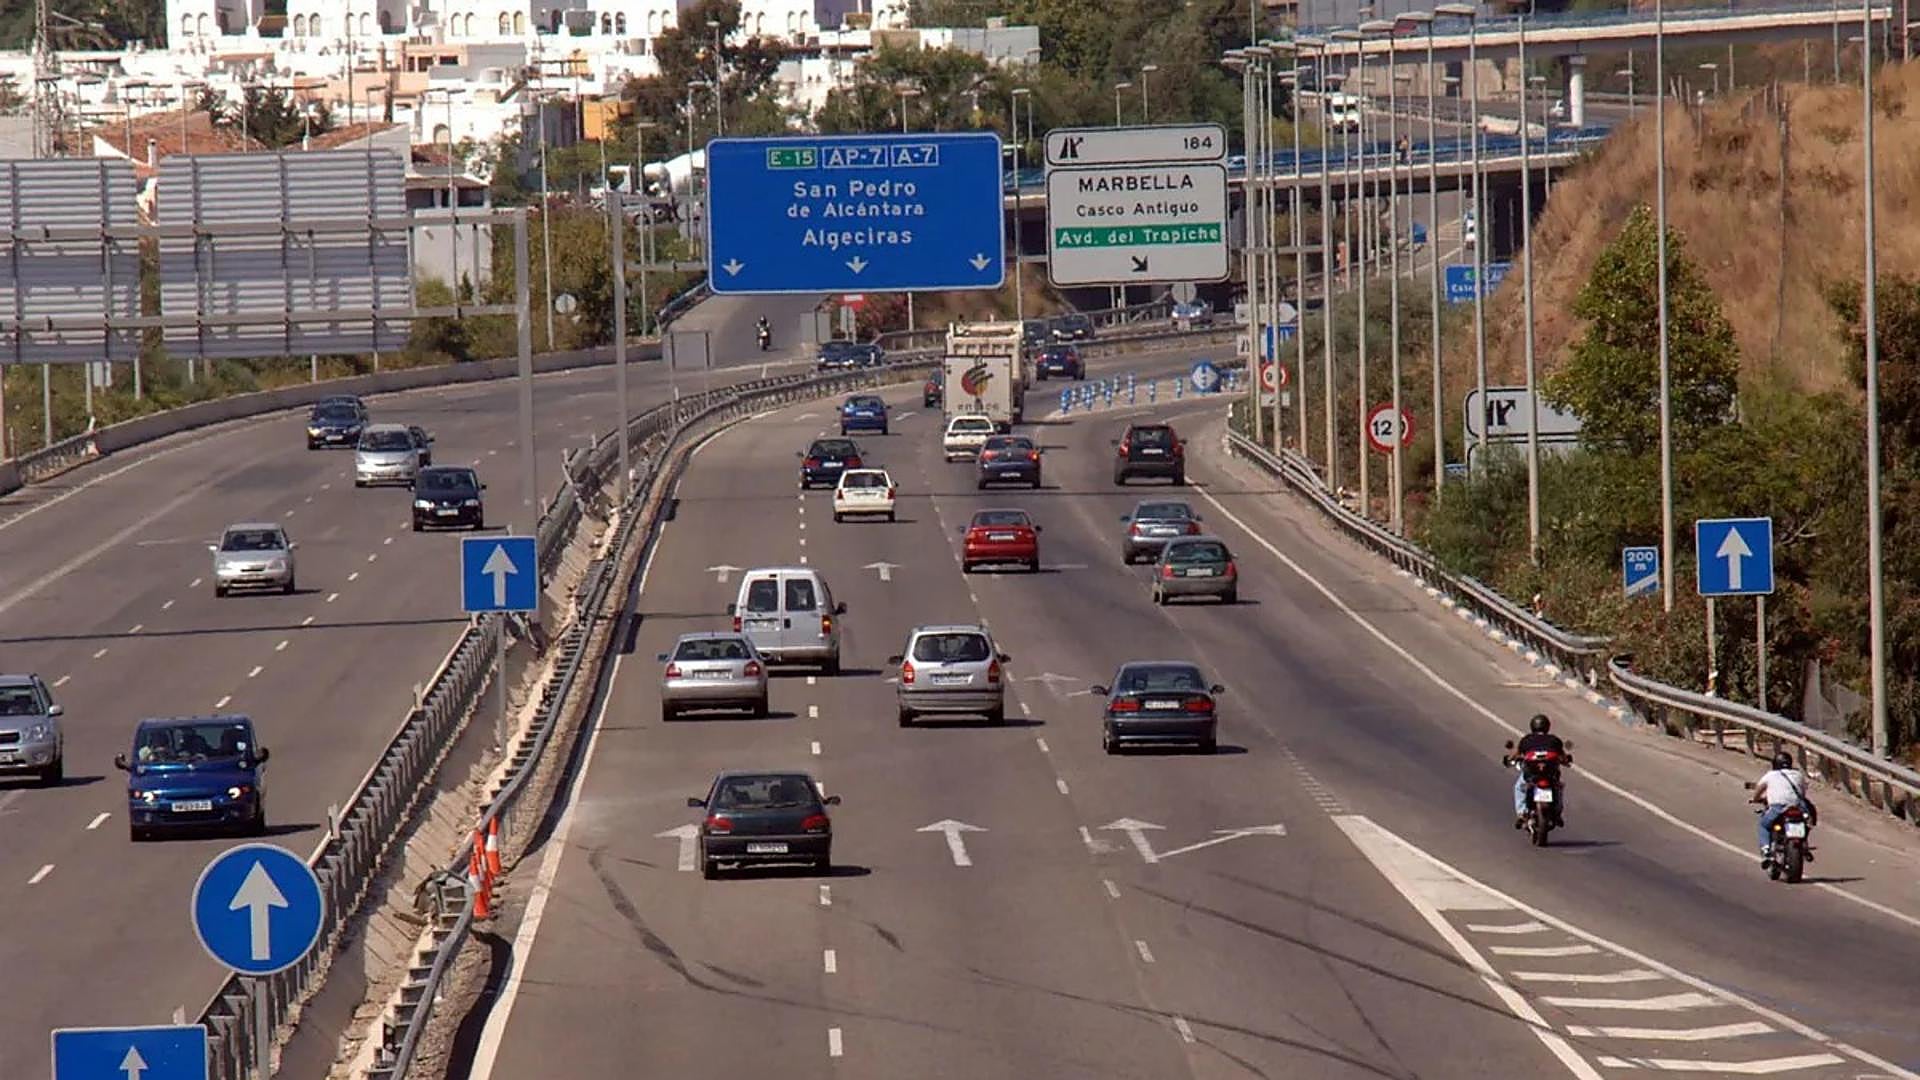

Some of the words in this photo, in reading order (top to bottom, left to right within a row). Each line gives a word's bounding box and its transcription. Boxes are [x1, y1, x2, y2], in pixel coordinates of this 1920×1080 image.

[1183, 136, 1213, 150] 184
[770, 150, 814, 166] E-15
[828, 148, 882, 166] AP-7
[897, 147, 933, 166] A-7
[793, 181, 837, 198] San
[849, 179, 917, 197] Pedro
[1078, 174, 1194, 193] MARBELLA
[787, 203, 811, 218] de
[823, 201, 925, 218] Alcántara
[1076, 204, 1125, 218] Casco
[1133, 202, 1199, 217] Antiguo
[802, 227, 913, 250] Algeciras
[1058, 231, 1099, 246] Avd.
[1107, 230, 1134, 244] del
[1143, 227, 1219, 246] Trapiche
[1626, 551, 1654, 562] 200
[1634, 563, 1647, 572] m
